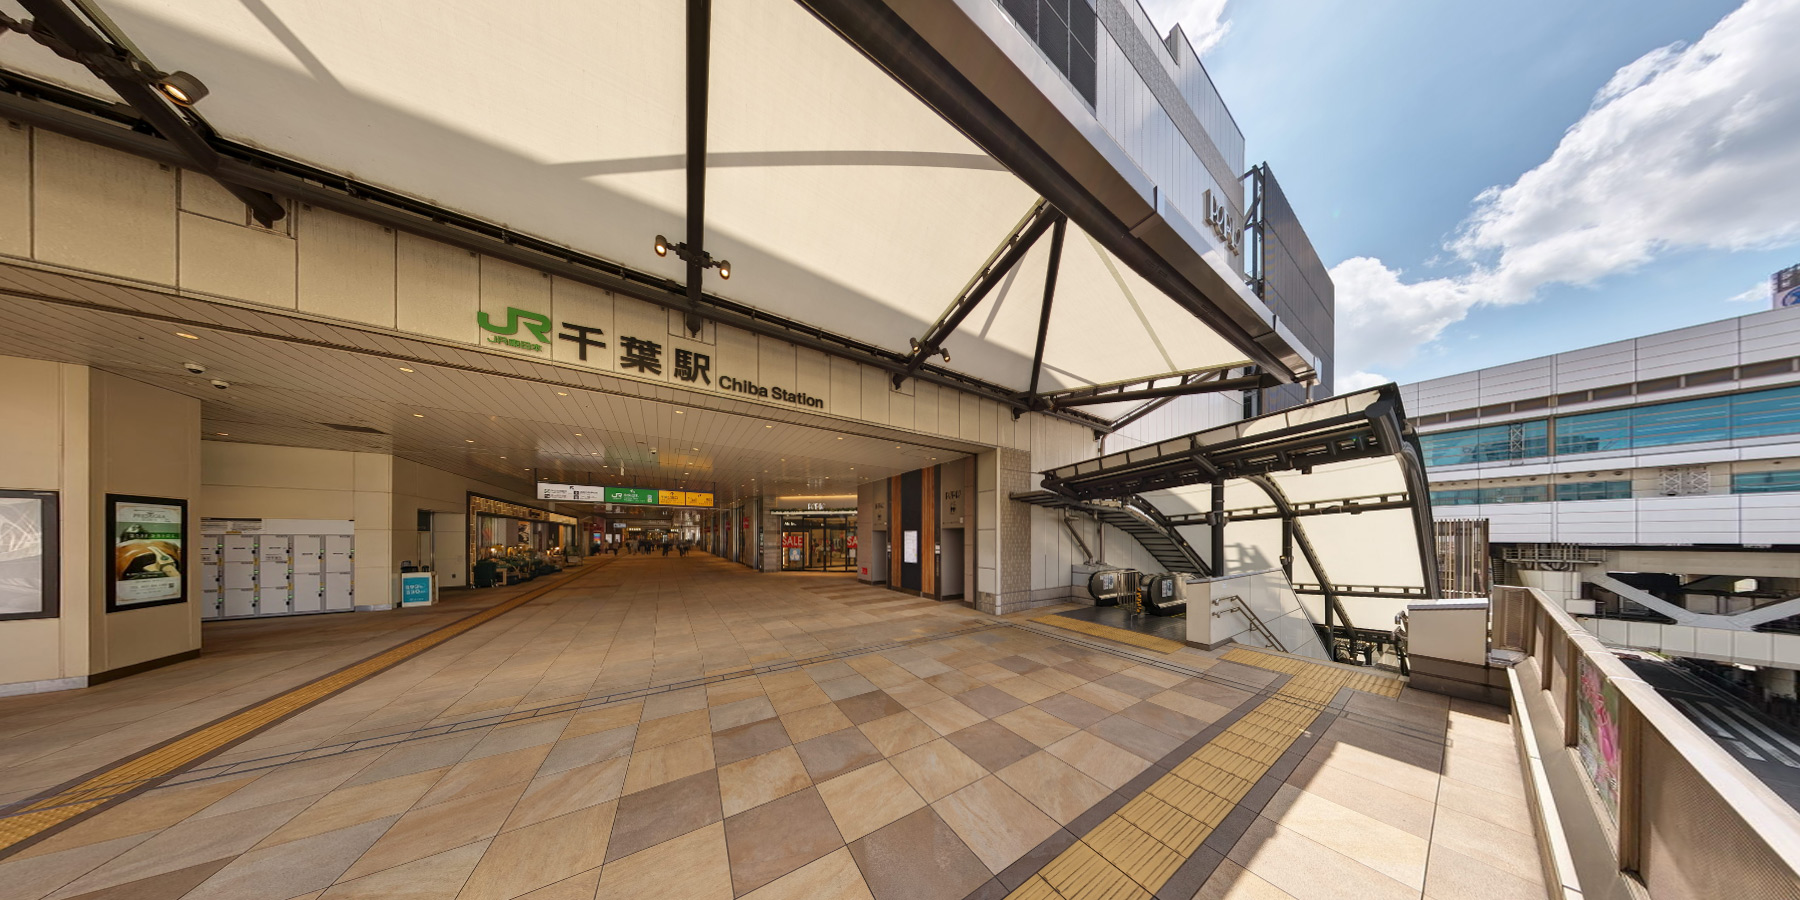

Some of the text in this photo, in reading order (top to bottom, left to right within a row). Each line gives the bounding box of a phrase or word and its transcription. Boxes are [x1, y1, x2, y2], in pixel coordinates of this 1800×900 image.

[477, 307, 552, 344] JR
[558, 322, 711, 386] 千葉駅
[718, 375, 824, 409] Chiba Station
[782, 535, 803, 546] SALE
